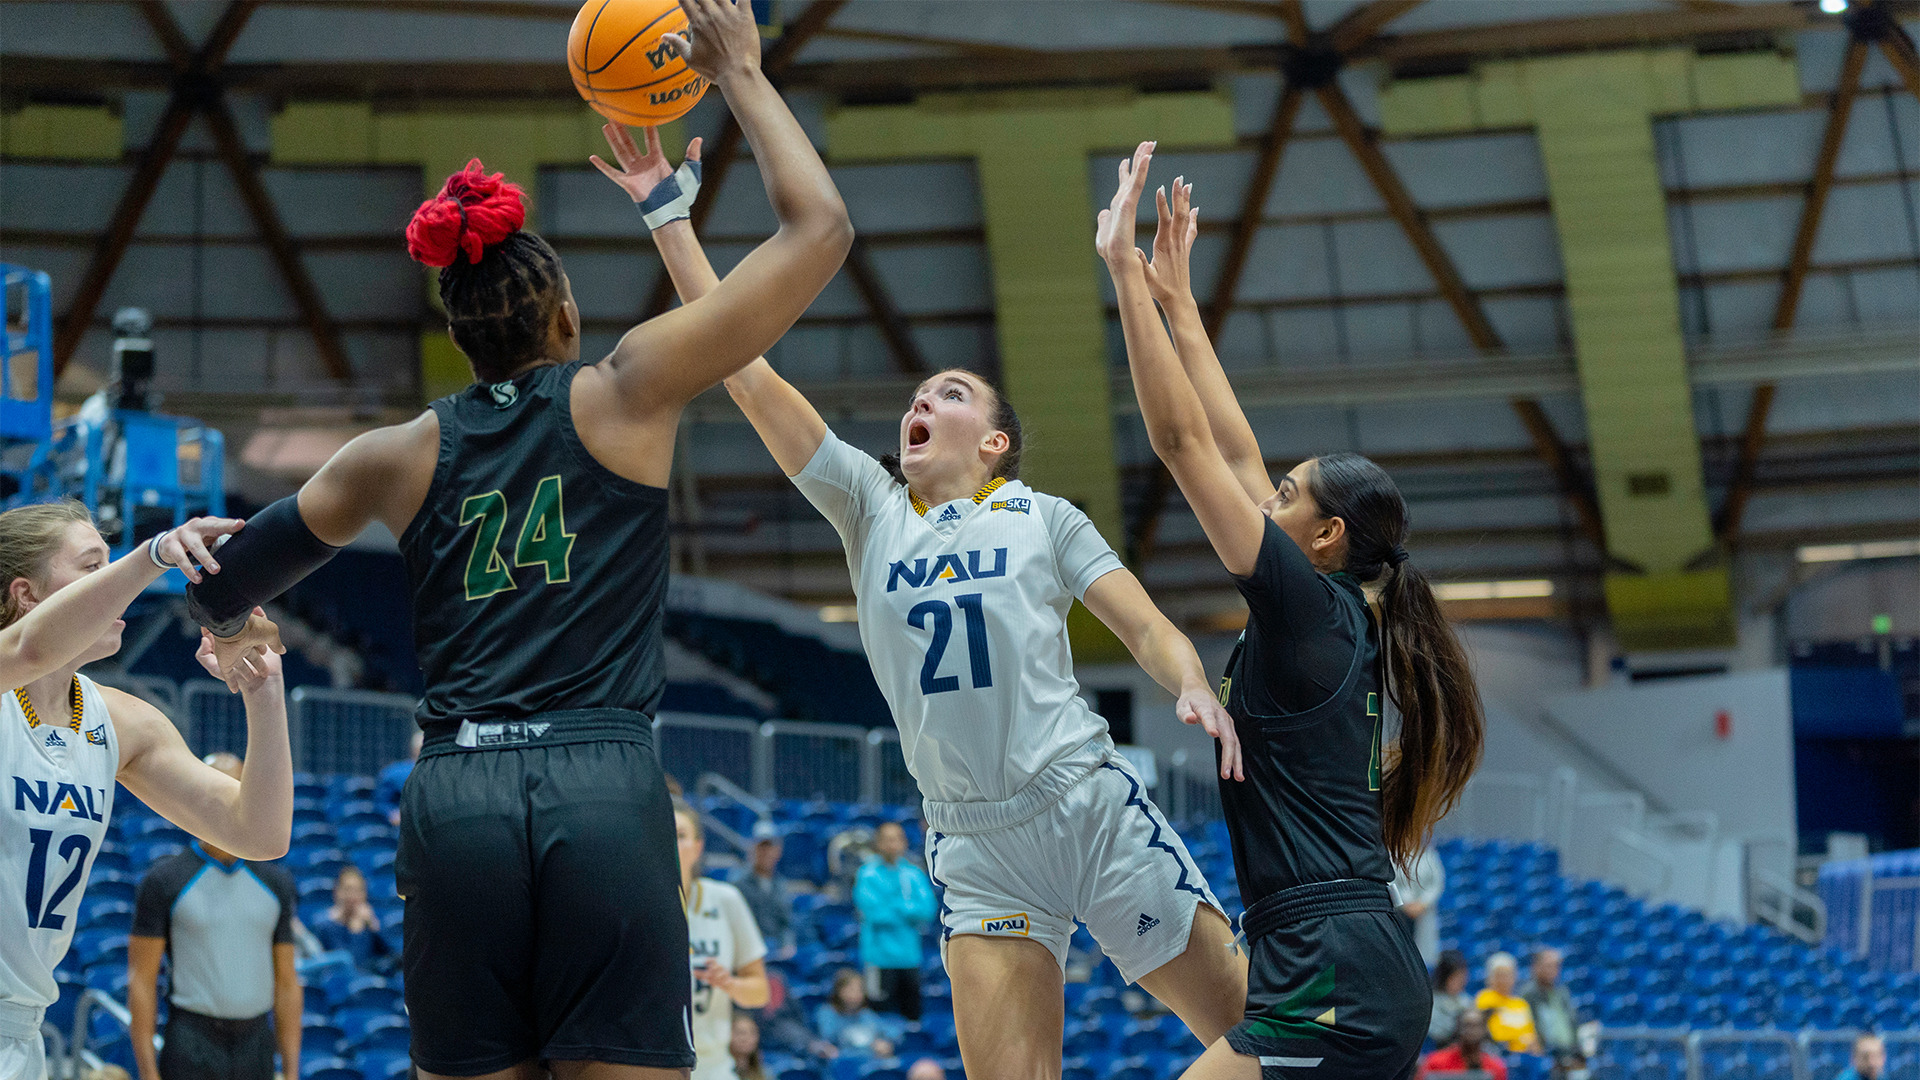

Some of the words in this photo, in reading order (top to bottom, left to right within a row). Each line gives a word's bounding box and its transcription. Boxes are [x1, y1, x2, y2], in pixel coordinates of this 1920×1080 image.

[459, 474, 577, 601] 24
[936, 513, 961, 524] adidas
[887, 547, 1008, 593] NAU
[907, 593, 993, 696] 21
[12, 776, 105, 823] NAU
[25, 827, 92, 931] 12
[987, 919, 1025, 932] NAU
[1136, 918, 1161, 937] adidas
